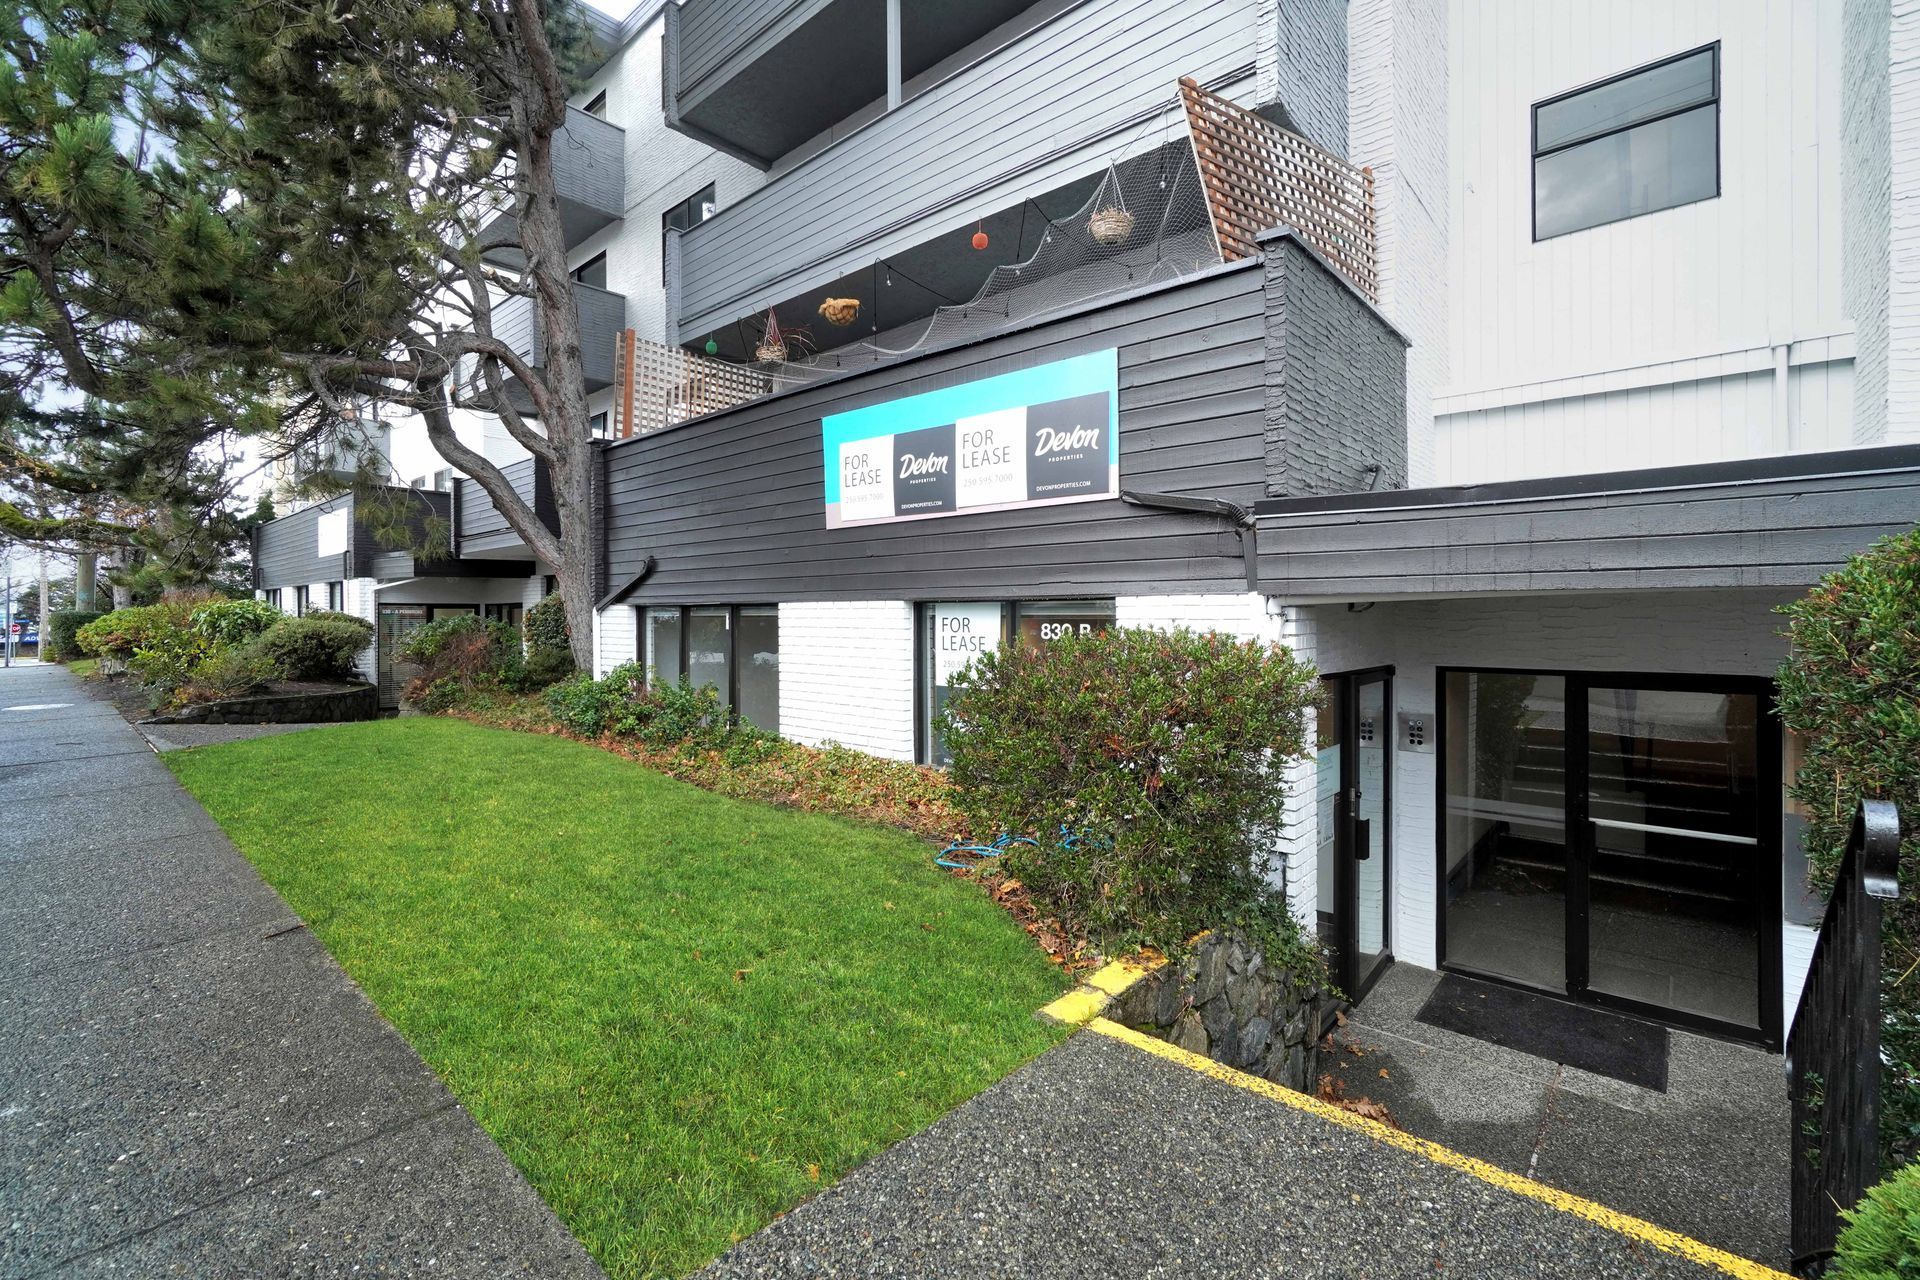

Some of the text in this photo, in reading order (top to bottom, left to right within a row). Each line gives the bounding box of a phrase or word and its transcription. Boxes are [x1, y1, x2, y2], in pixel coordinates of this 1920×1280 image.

[962, 429, 994, 449] FOR
[1034, 424, 1100, 457] Devon
[844, 453, 869, 471] FOR
[899, 451, 949, 479] Devon
[962, 445, 1011, 469] LEASE
[1048, 453, 1084, 463] PROPERTIES
[844, 468, 882, 488] LEASE
[909, 477, 937, 485] PROPERTIES
[1036, 481, 1091, 491] DEVONPROPERTIES.COM
[941, 616, 971, 633] FOR
[941, 635, 986, 652] LEASE
